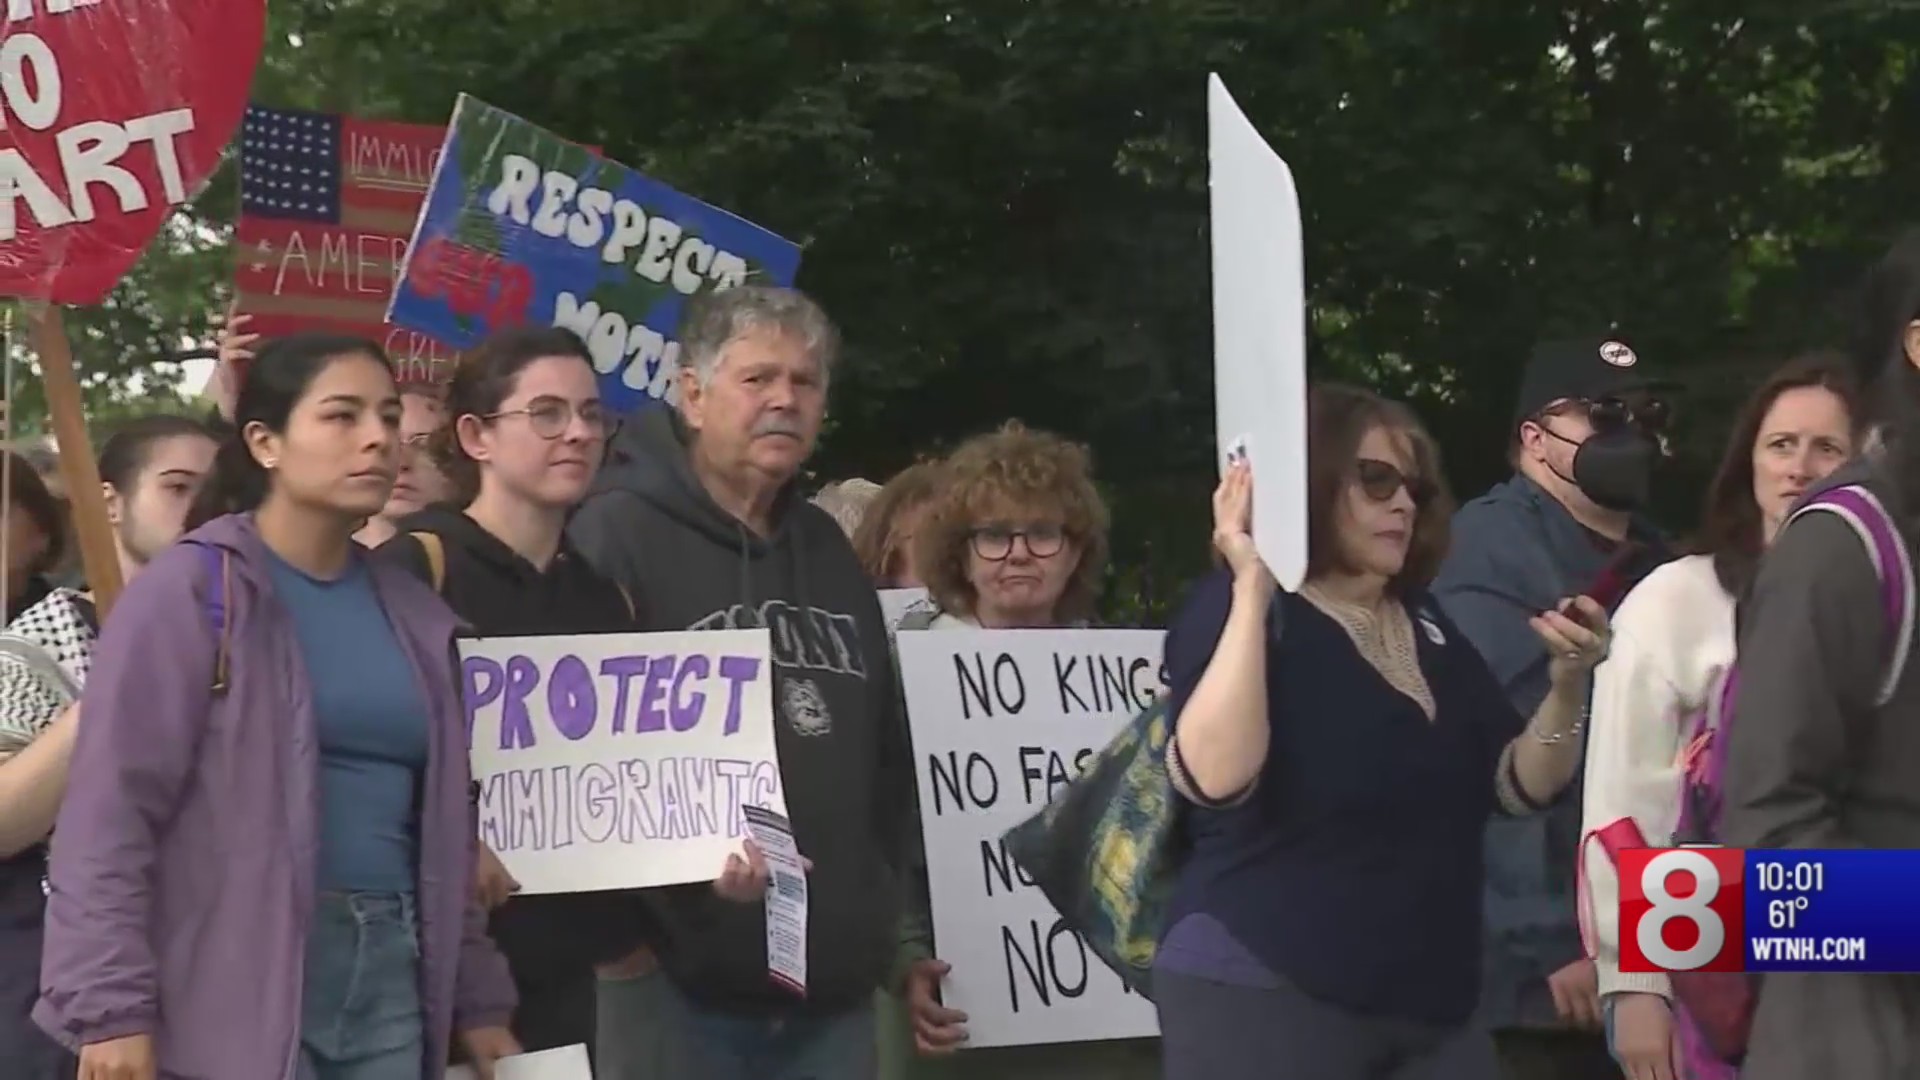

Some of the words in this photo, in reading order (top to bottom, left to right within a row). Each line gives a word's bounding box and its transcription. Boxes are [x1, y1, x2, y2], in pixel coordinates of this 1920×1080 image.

[462, 654, 761, 751] PROTECT
[953, 653, 1026, 719] NO
[929, 750, 998, 816] NO
[1001, 917, 1088, 1014] NO
